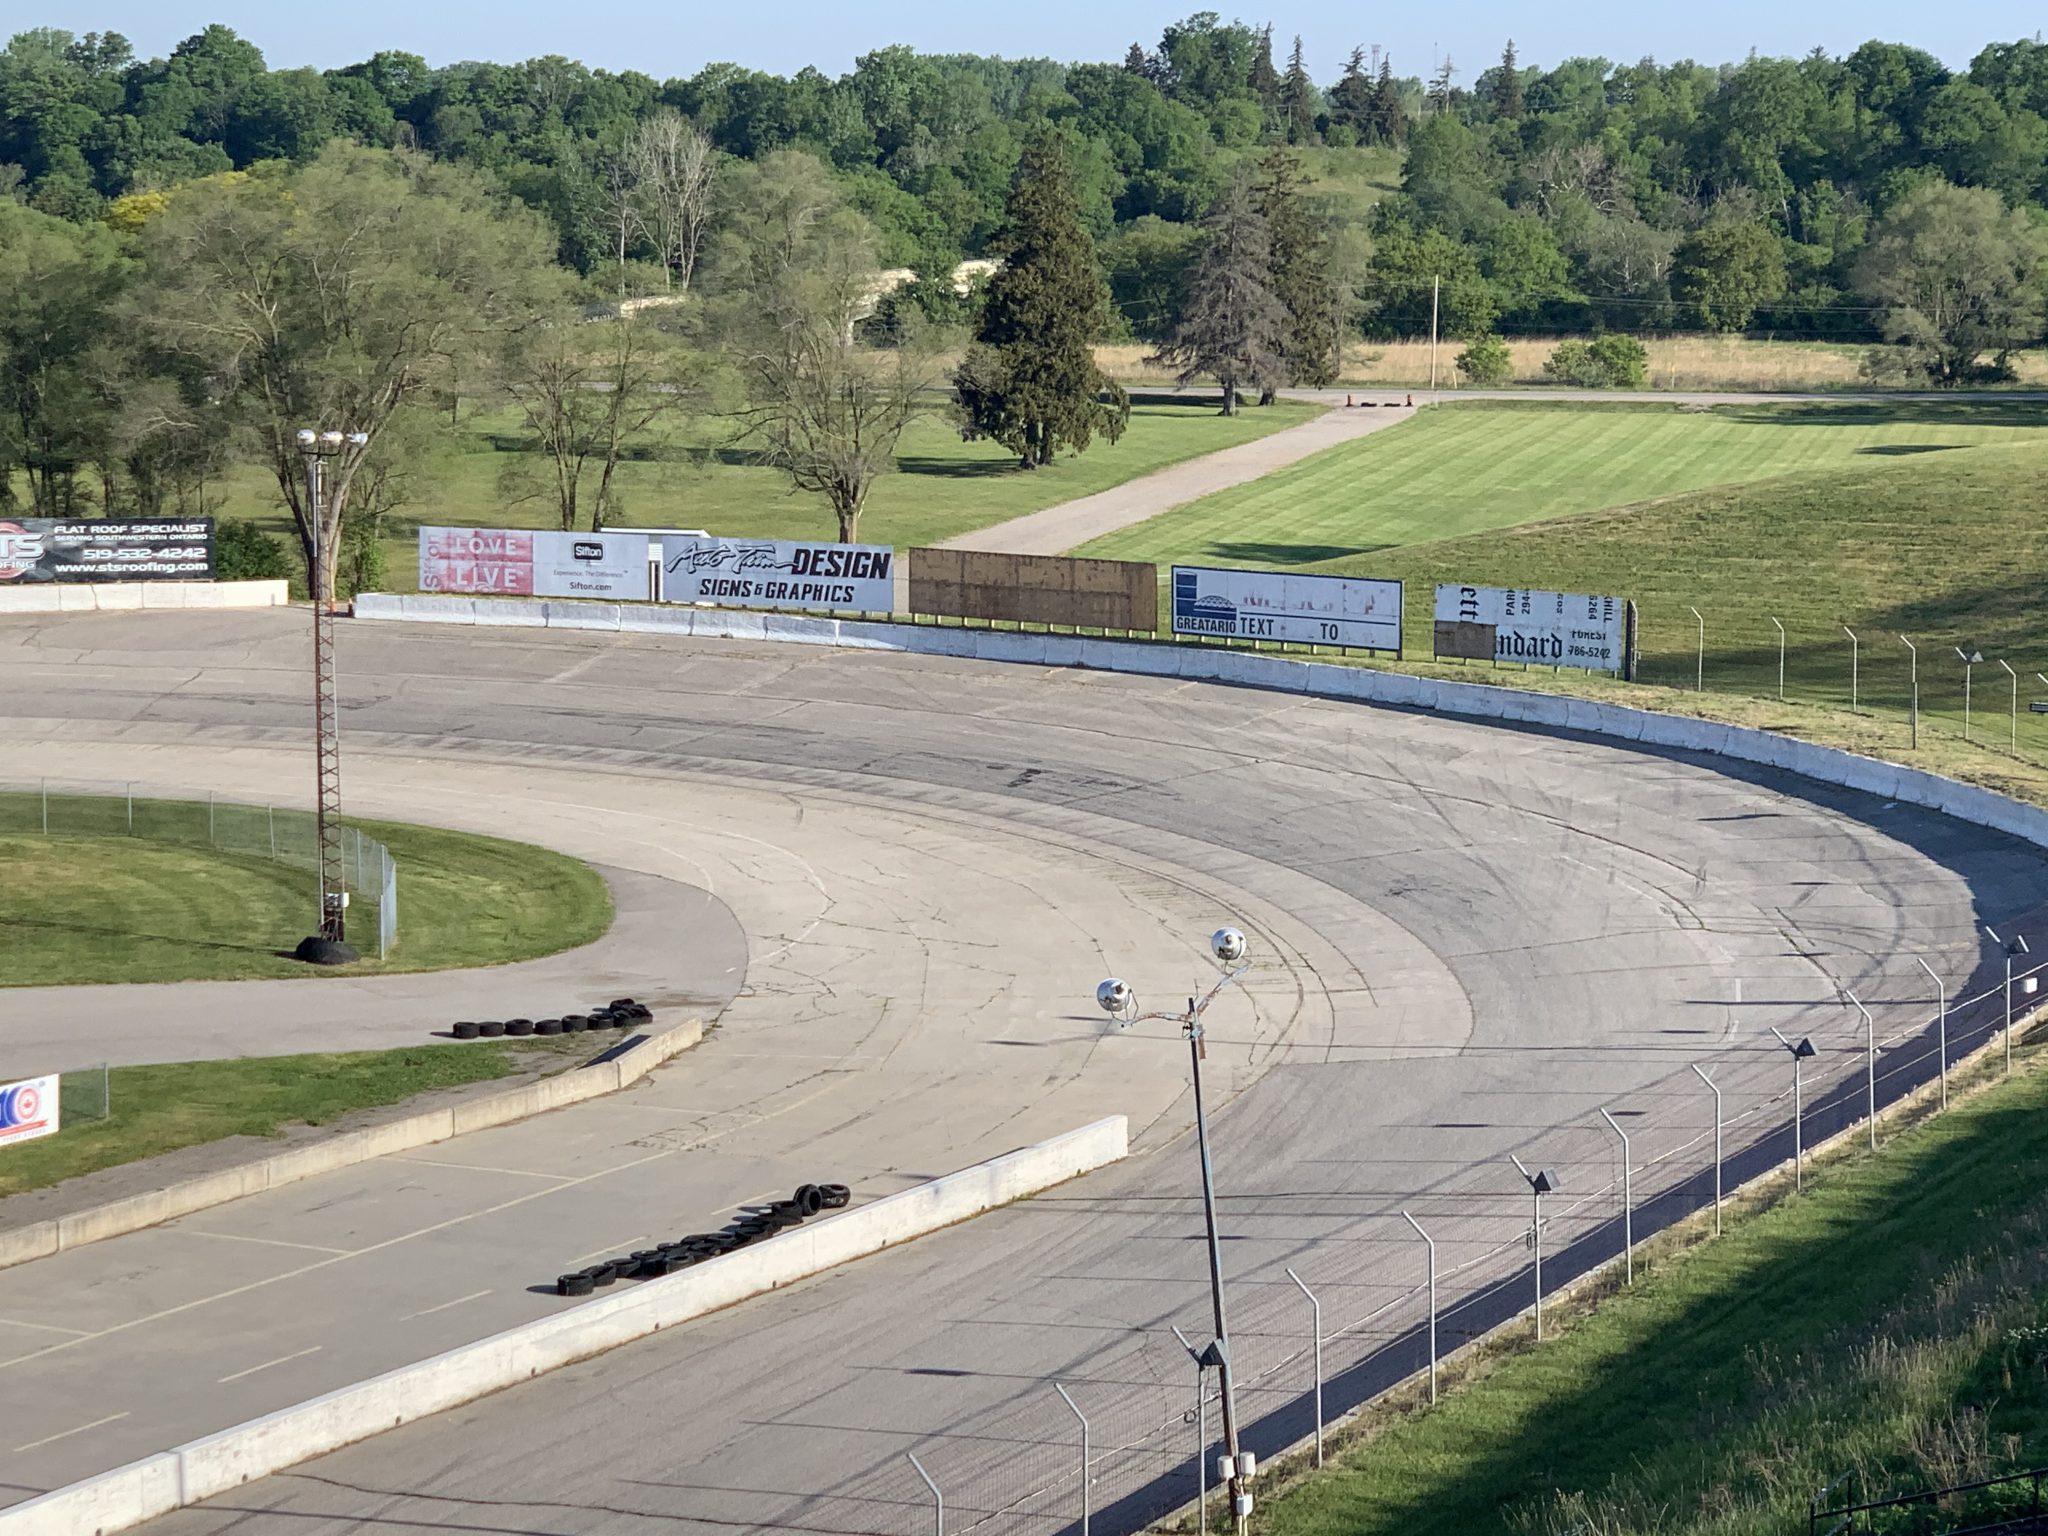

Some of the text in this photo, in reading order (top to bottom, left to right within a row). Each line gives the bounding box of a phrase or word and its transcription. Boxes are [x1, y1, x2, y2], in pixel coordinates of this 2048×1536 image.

[54, 524, 207, 534] FLAT ROOF SPECIALIST
[82, 548, 207, 560] 519-532-4242
[456, 537, 517, 556] LOVE
[575, 545, 602, 557] Sifton
[55, 562, 208, 573] www.stsroofing.com
[665, 541, 892, 579] Auto Trim DESIGN
[456, 565, 518, 588] LIVE
[569, 581, 612, 591] Sifton.com
[700, 578, 752, 598] SIGNS
[765, 582, 855, 603] GRAPHICS
[1176, 616, 1236, 635] GREATARIO
[1240, 617, 1339, 641] TEXT TO
